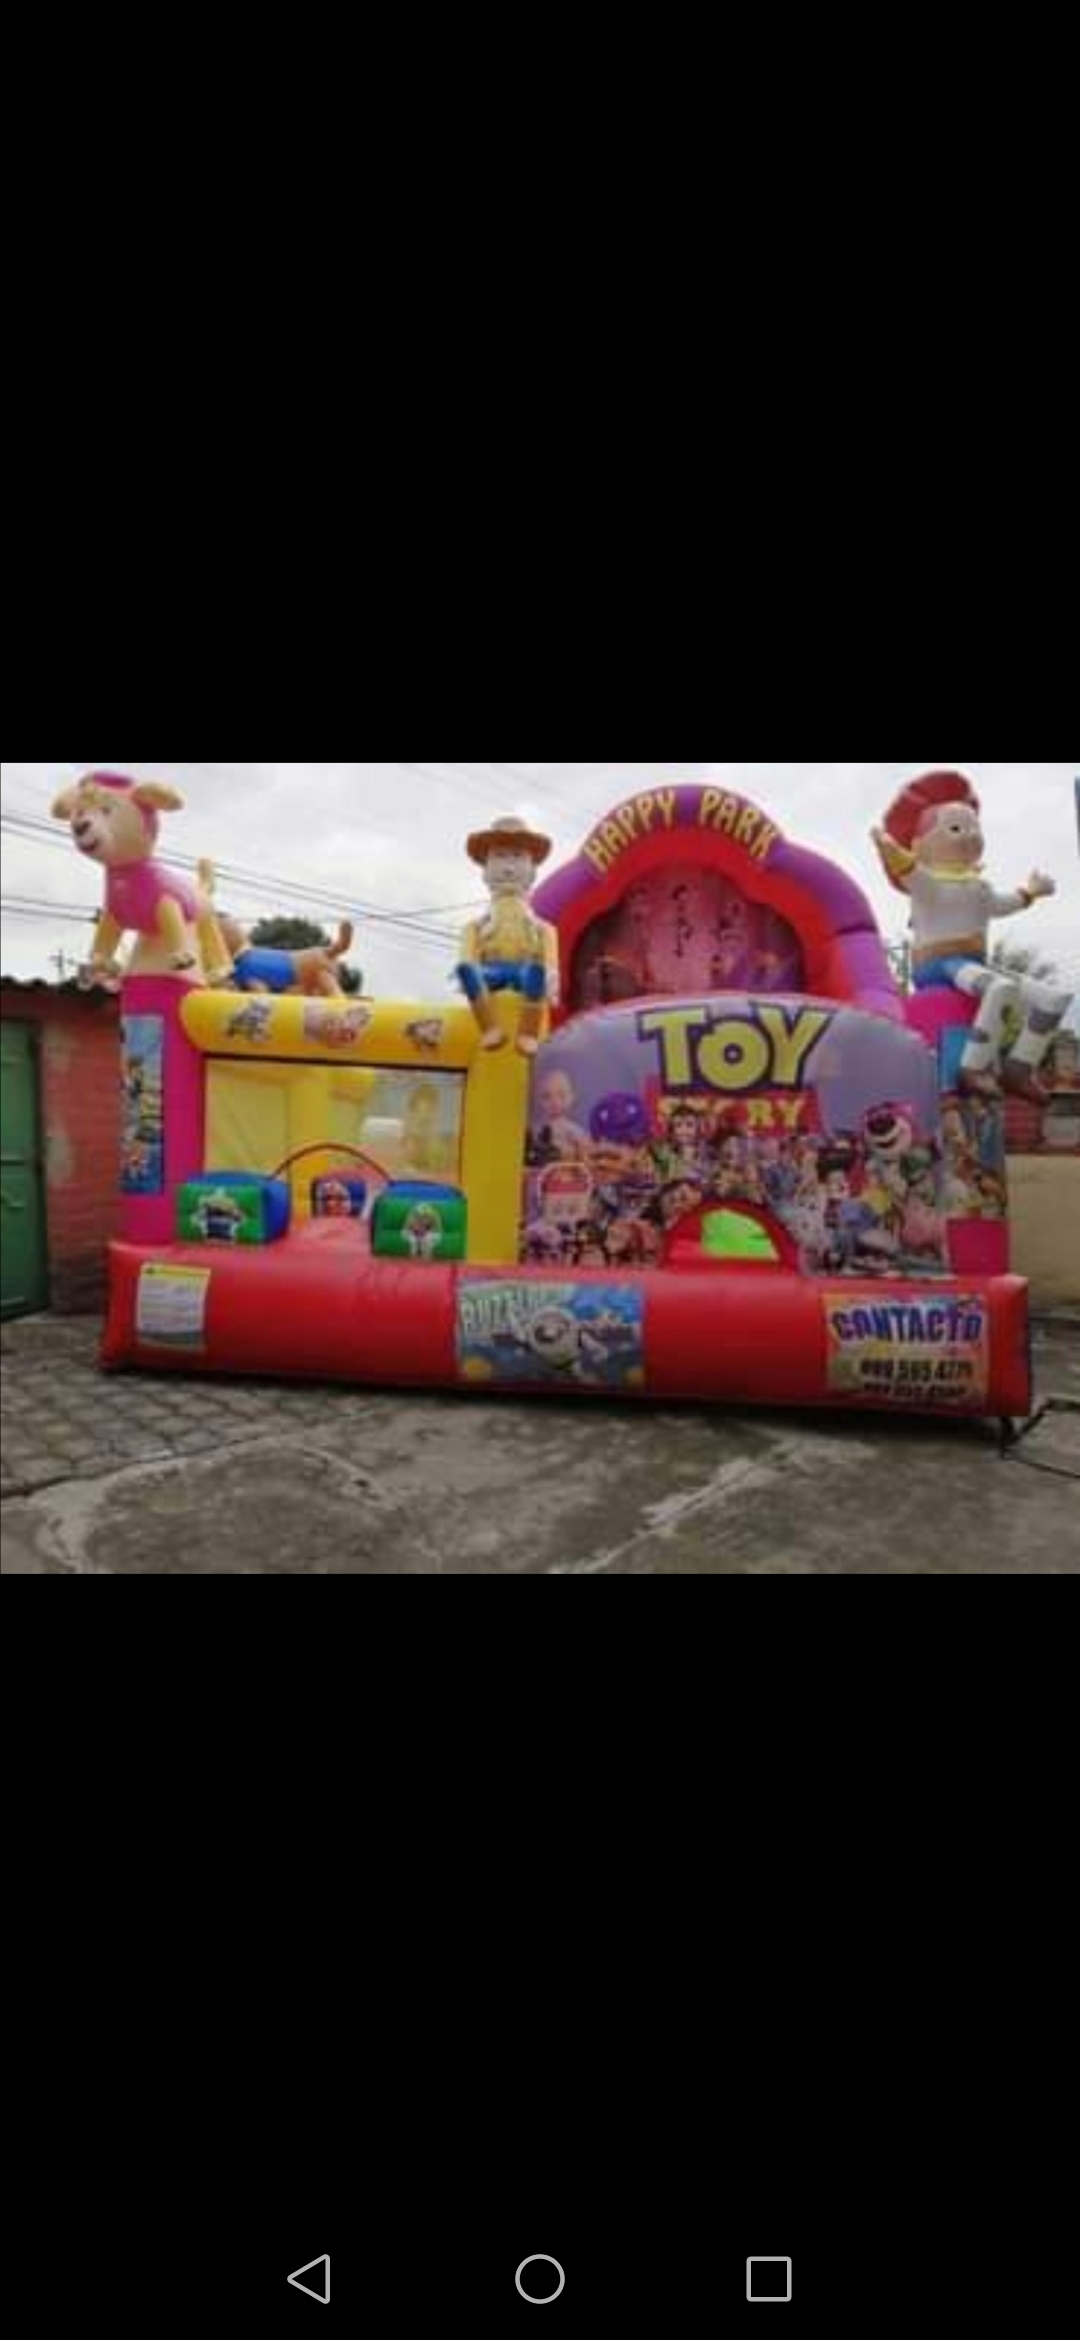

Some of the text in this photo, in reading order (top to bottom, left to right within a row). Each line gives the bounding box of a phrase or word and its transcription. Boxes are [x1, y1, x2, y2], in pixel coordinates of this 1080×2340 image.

[583, 789, 779, 873] HAPPY PARK
[832, 1306, 982, 1342] CONTACTO
